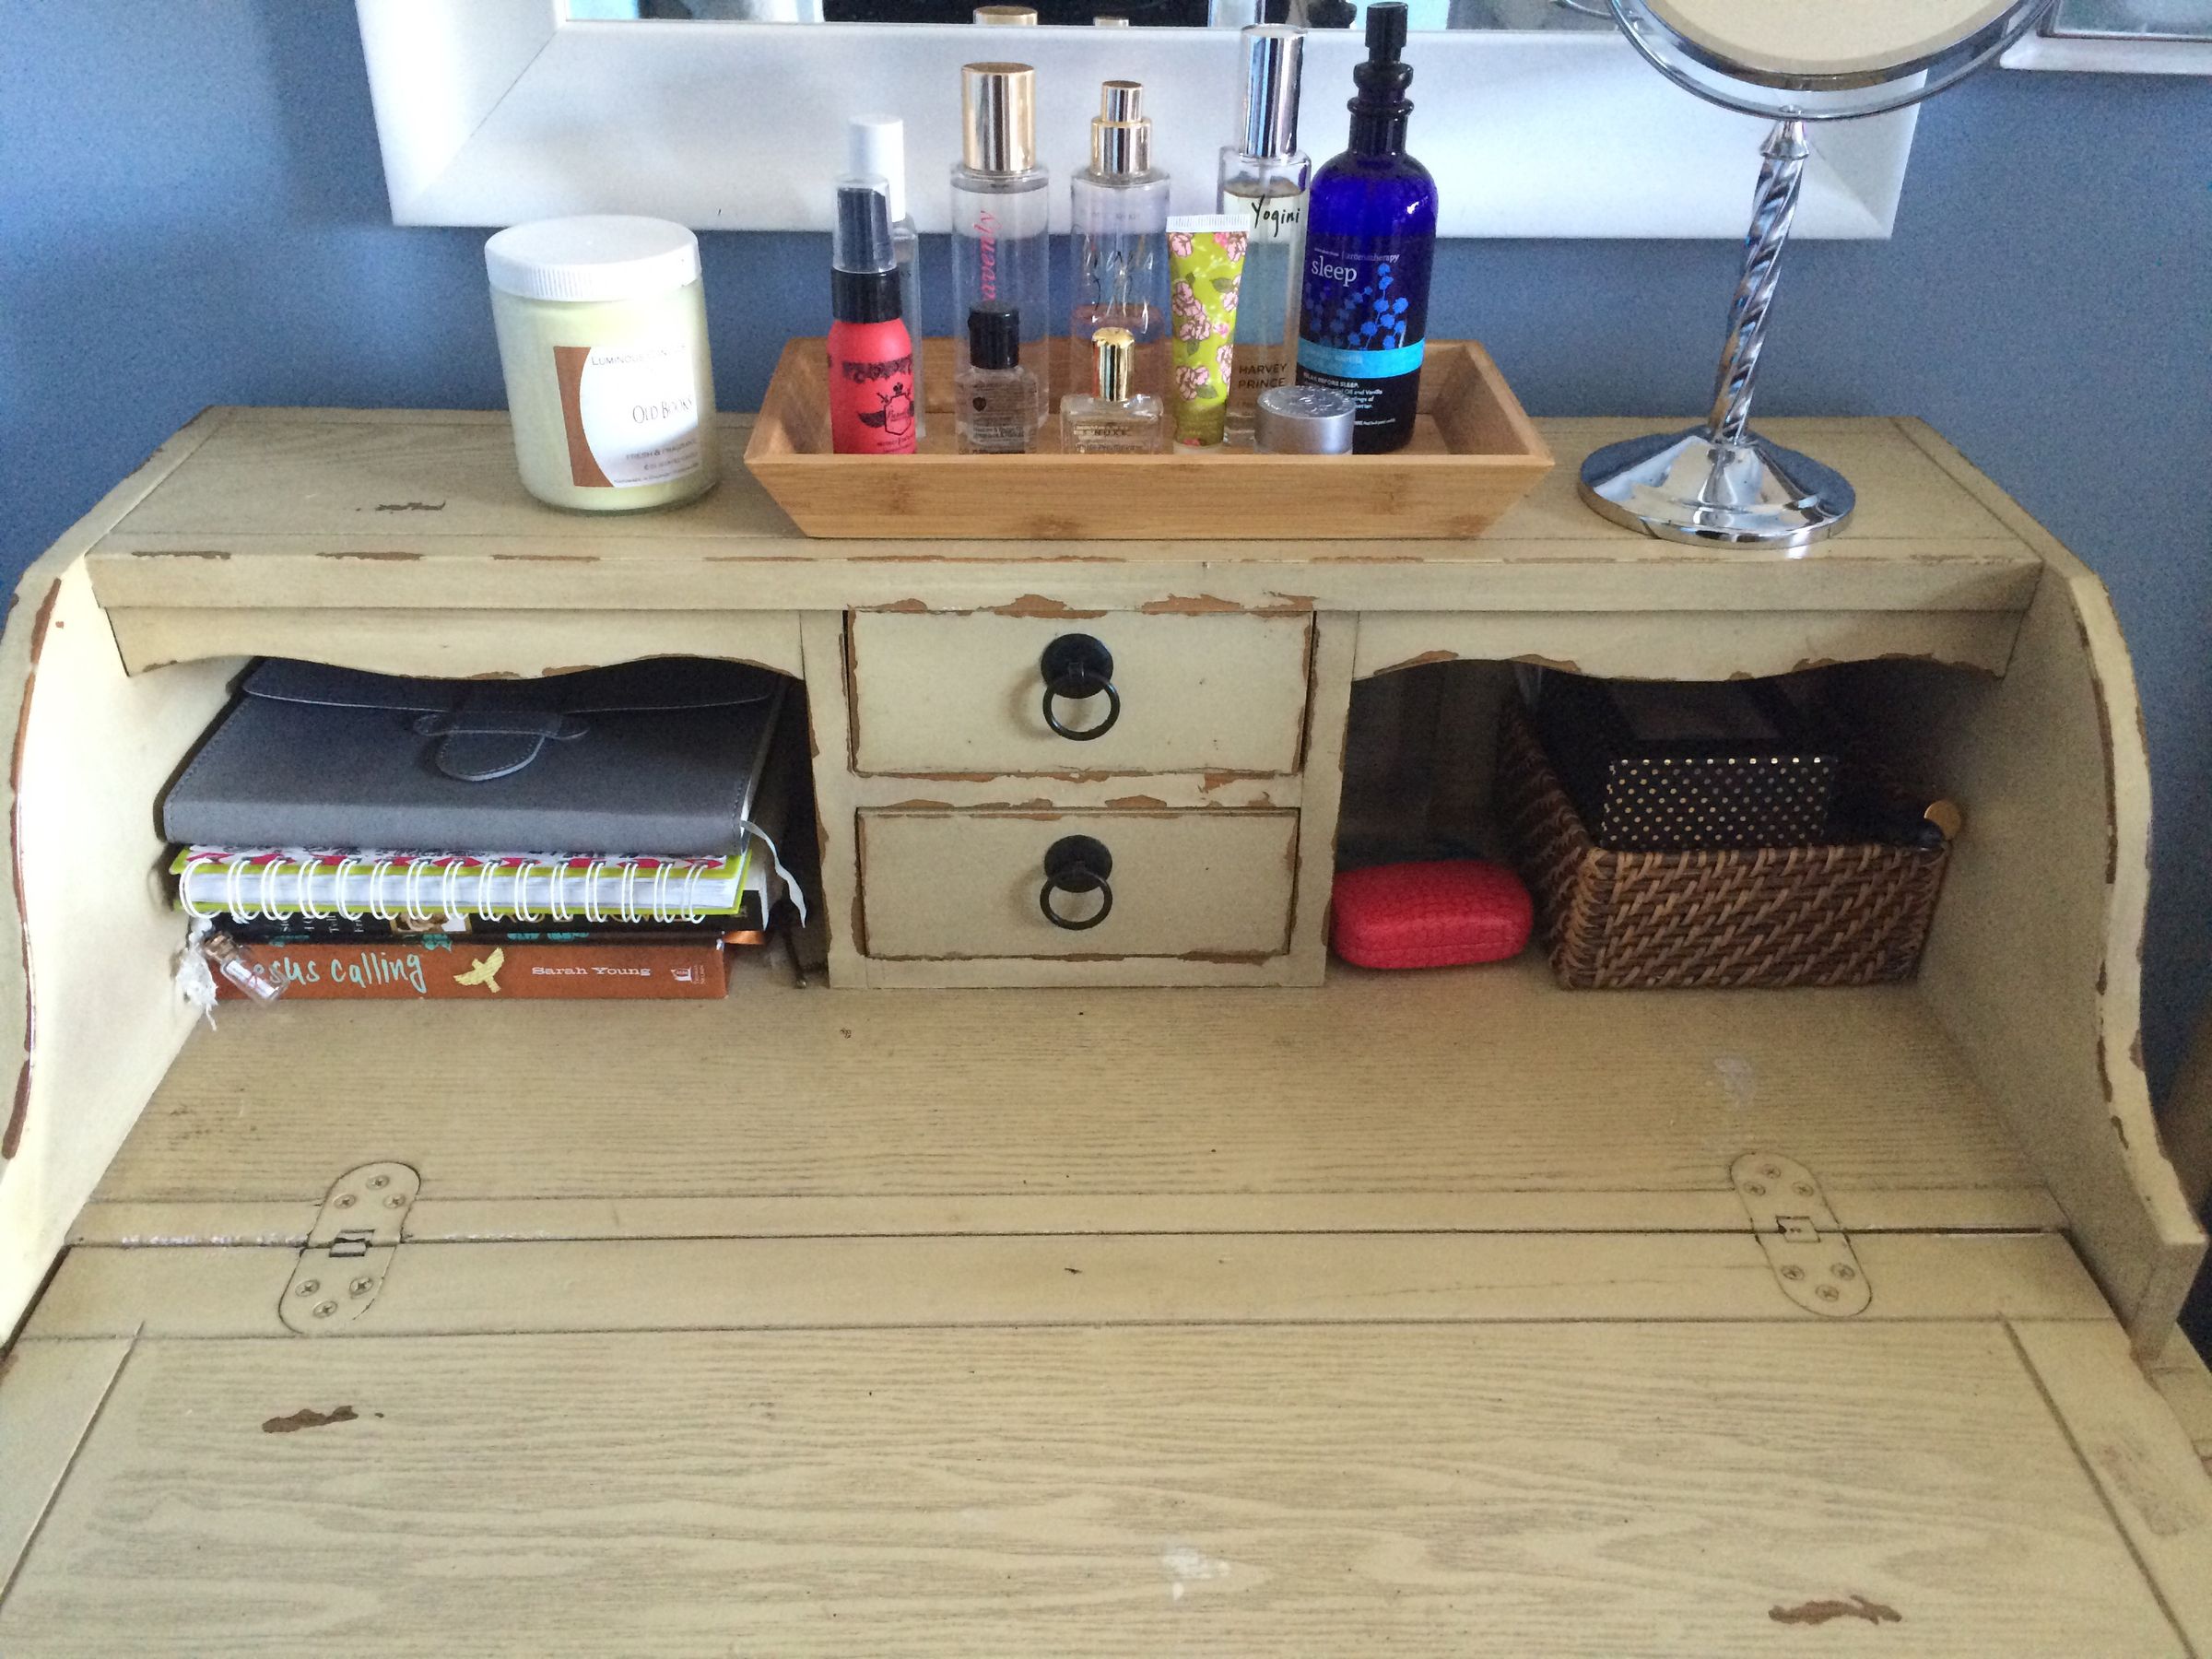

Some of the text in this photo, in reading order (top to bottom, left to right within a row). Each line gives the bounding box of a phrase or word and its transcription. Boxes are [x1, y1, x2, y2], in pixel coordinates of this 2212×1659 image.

[1251, 194, 1300, 238] Yogini
[972, 209, 1003, 303] avenly
[1311, 255, 1358, 288] sleep
[1238, 377, 1287, 389] PRINCE
[1239, 362, 1288, 375] HARVEY
[253, 952, 428, 994] esus calling
[531, 966, 651, 977] Sarah Young
